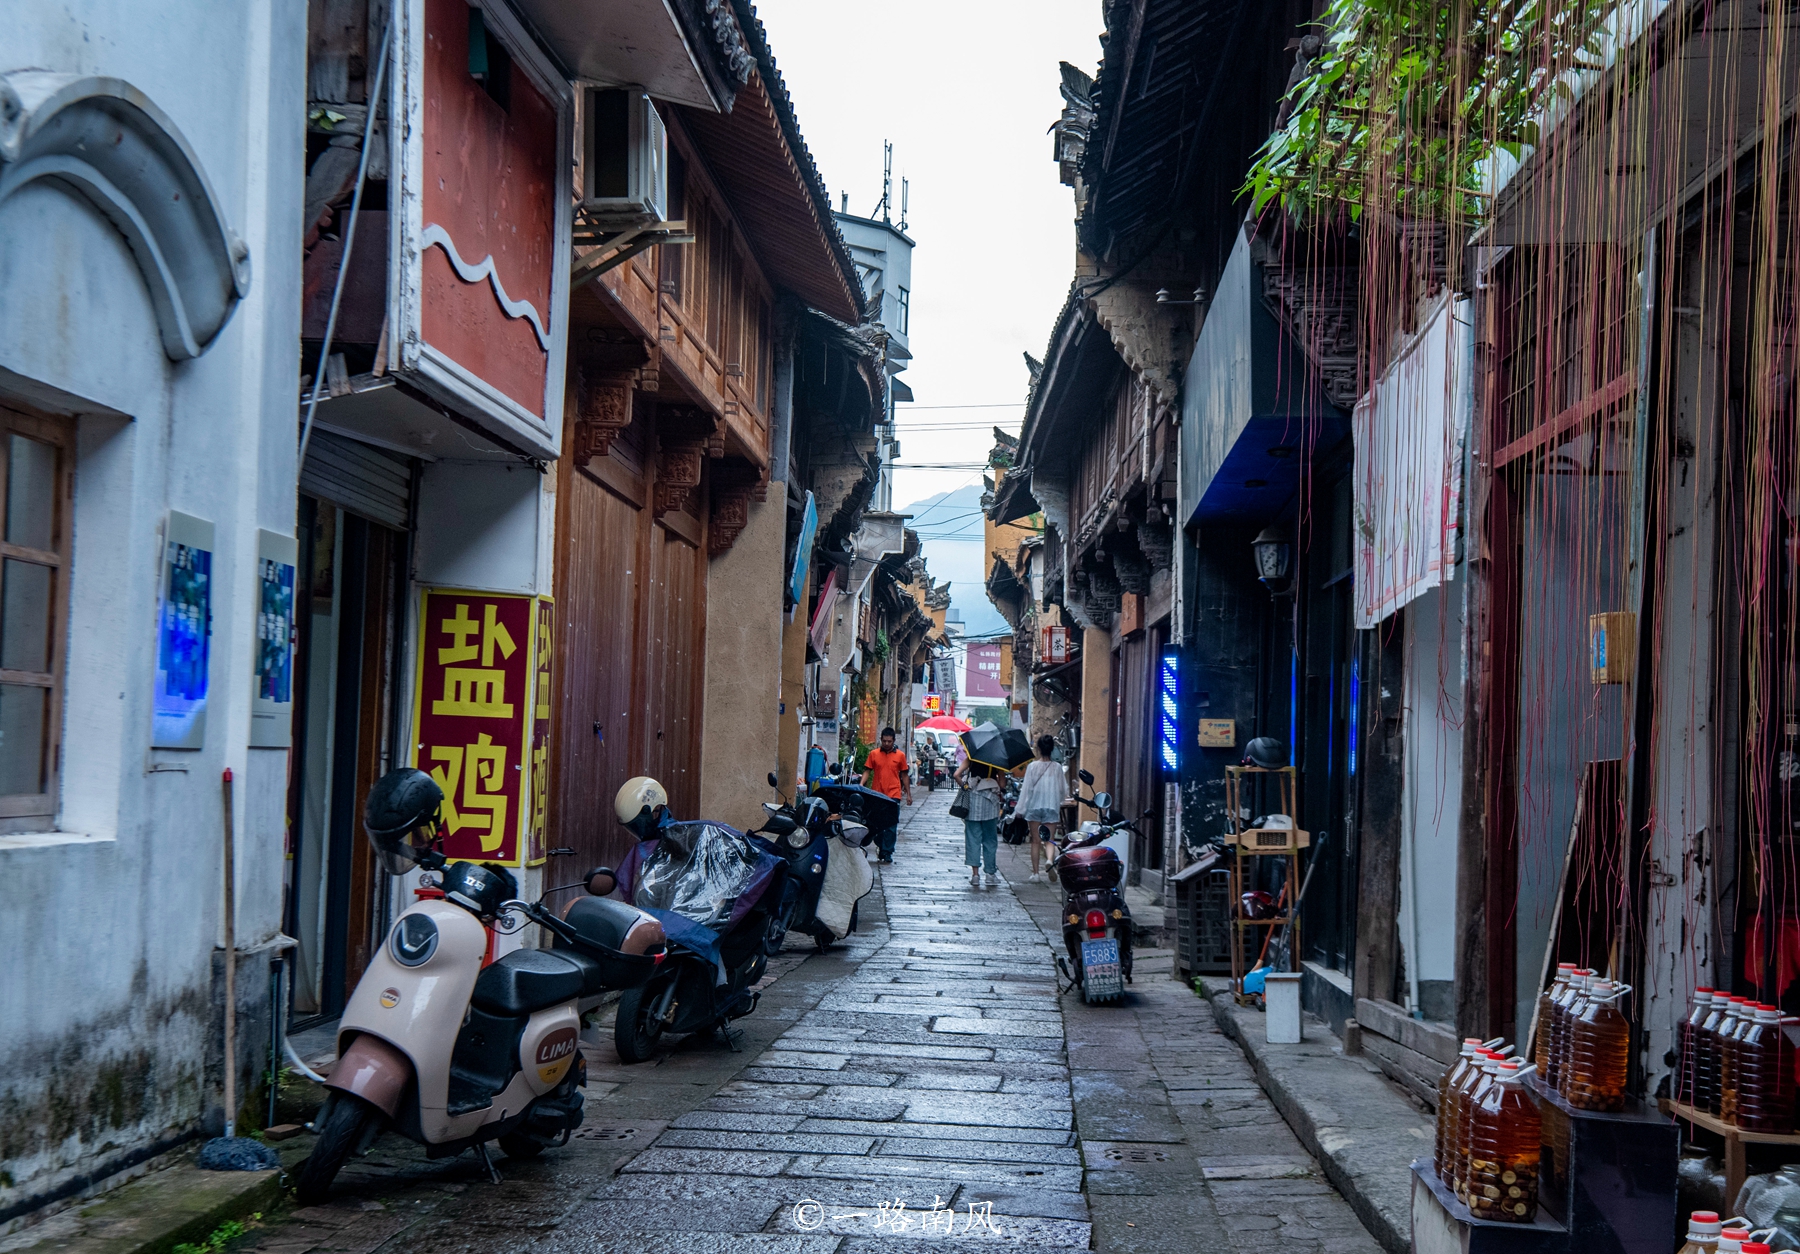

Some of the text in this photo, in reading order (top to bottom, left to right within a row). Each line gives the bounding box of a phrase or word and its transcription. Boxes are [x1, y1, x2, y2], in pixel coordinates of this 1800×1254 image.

[1052, 638, 1065, 652] 茶
[989, 671, 1001, 680] 开
[430, 603, 518, 853] 盐鸡
[1084, 947, 1117, 964] F5883
[540, 1037, 575, 1061] LIMA
